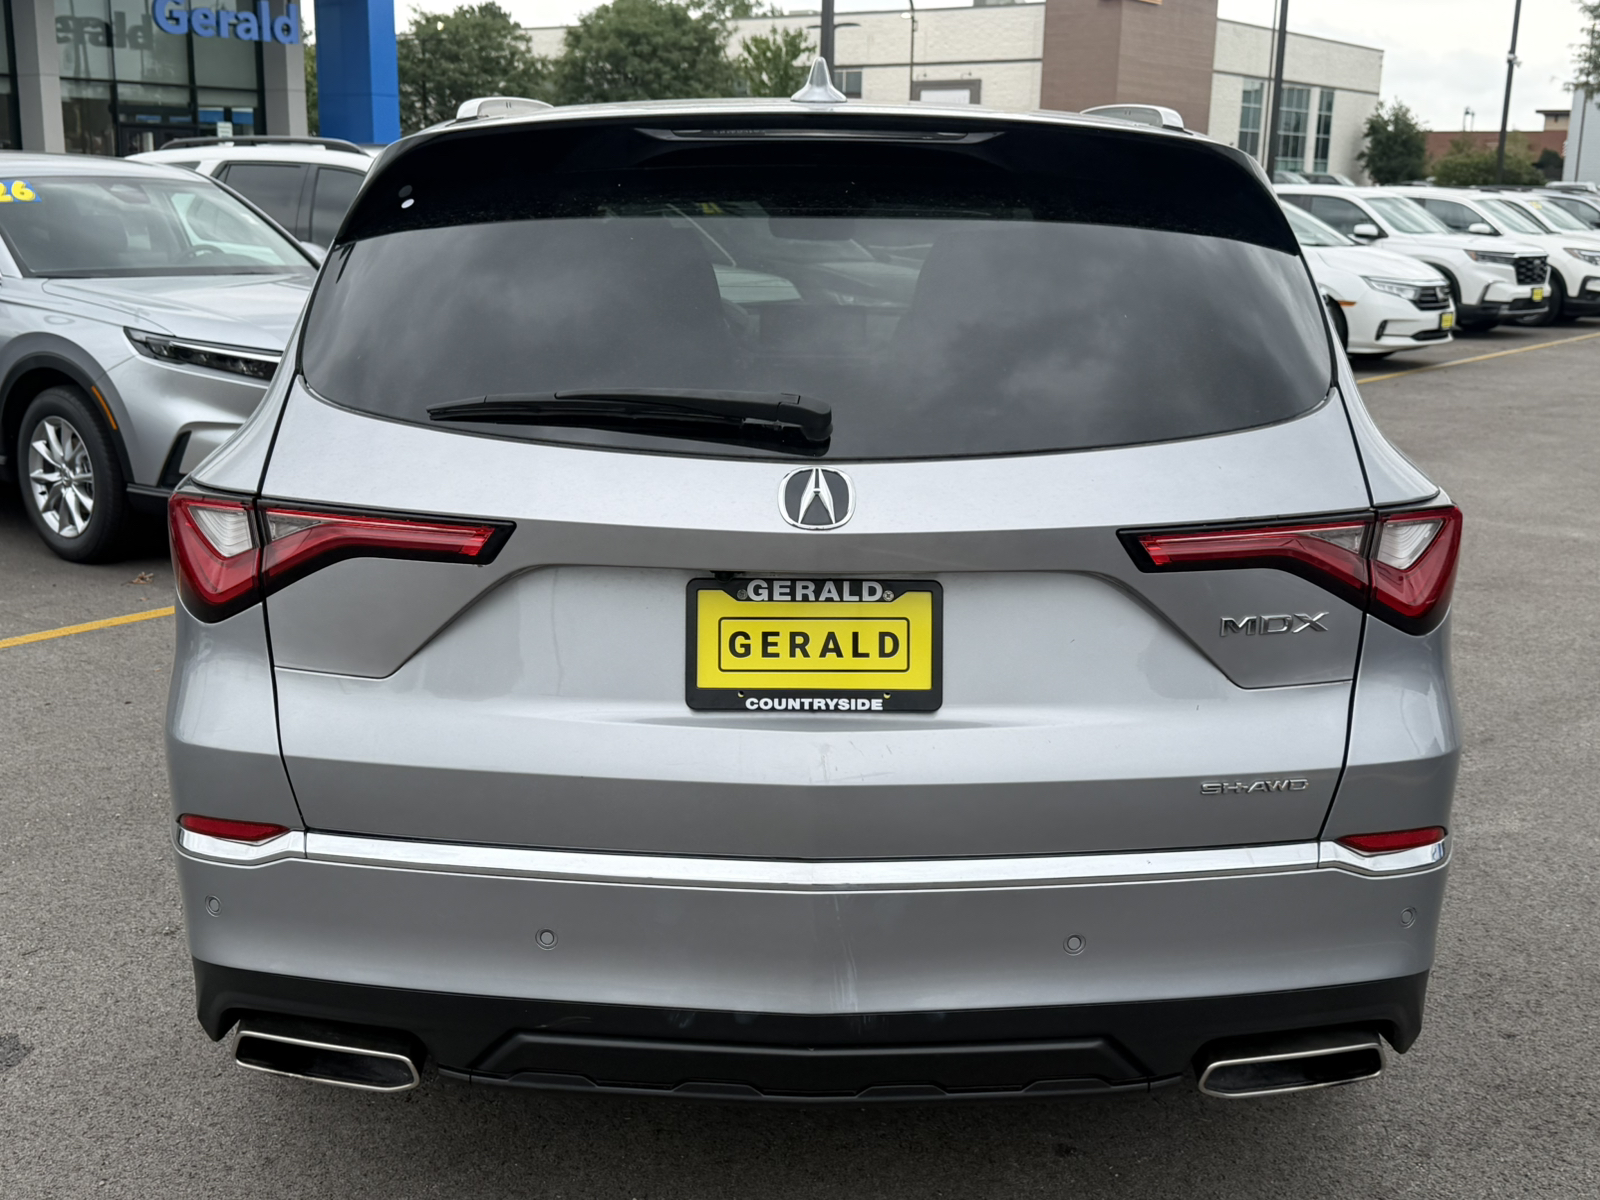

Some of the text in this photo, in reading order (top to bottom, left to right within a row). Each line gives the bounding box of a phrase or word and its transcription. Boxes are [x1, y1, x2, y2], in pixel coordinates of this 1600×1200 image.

[153, 0, 299, 44] Gerald
[747, 579, 884, 602] GERALD
[1219, 611, 1330, 637] MDX
[728, 631, 900, 659] GERALD
[745, 697, 884, 711] COUNTRYSIDE
[1200, 778, 1310, 796] SH-AWD
